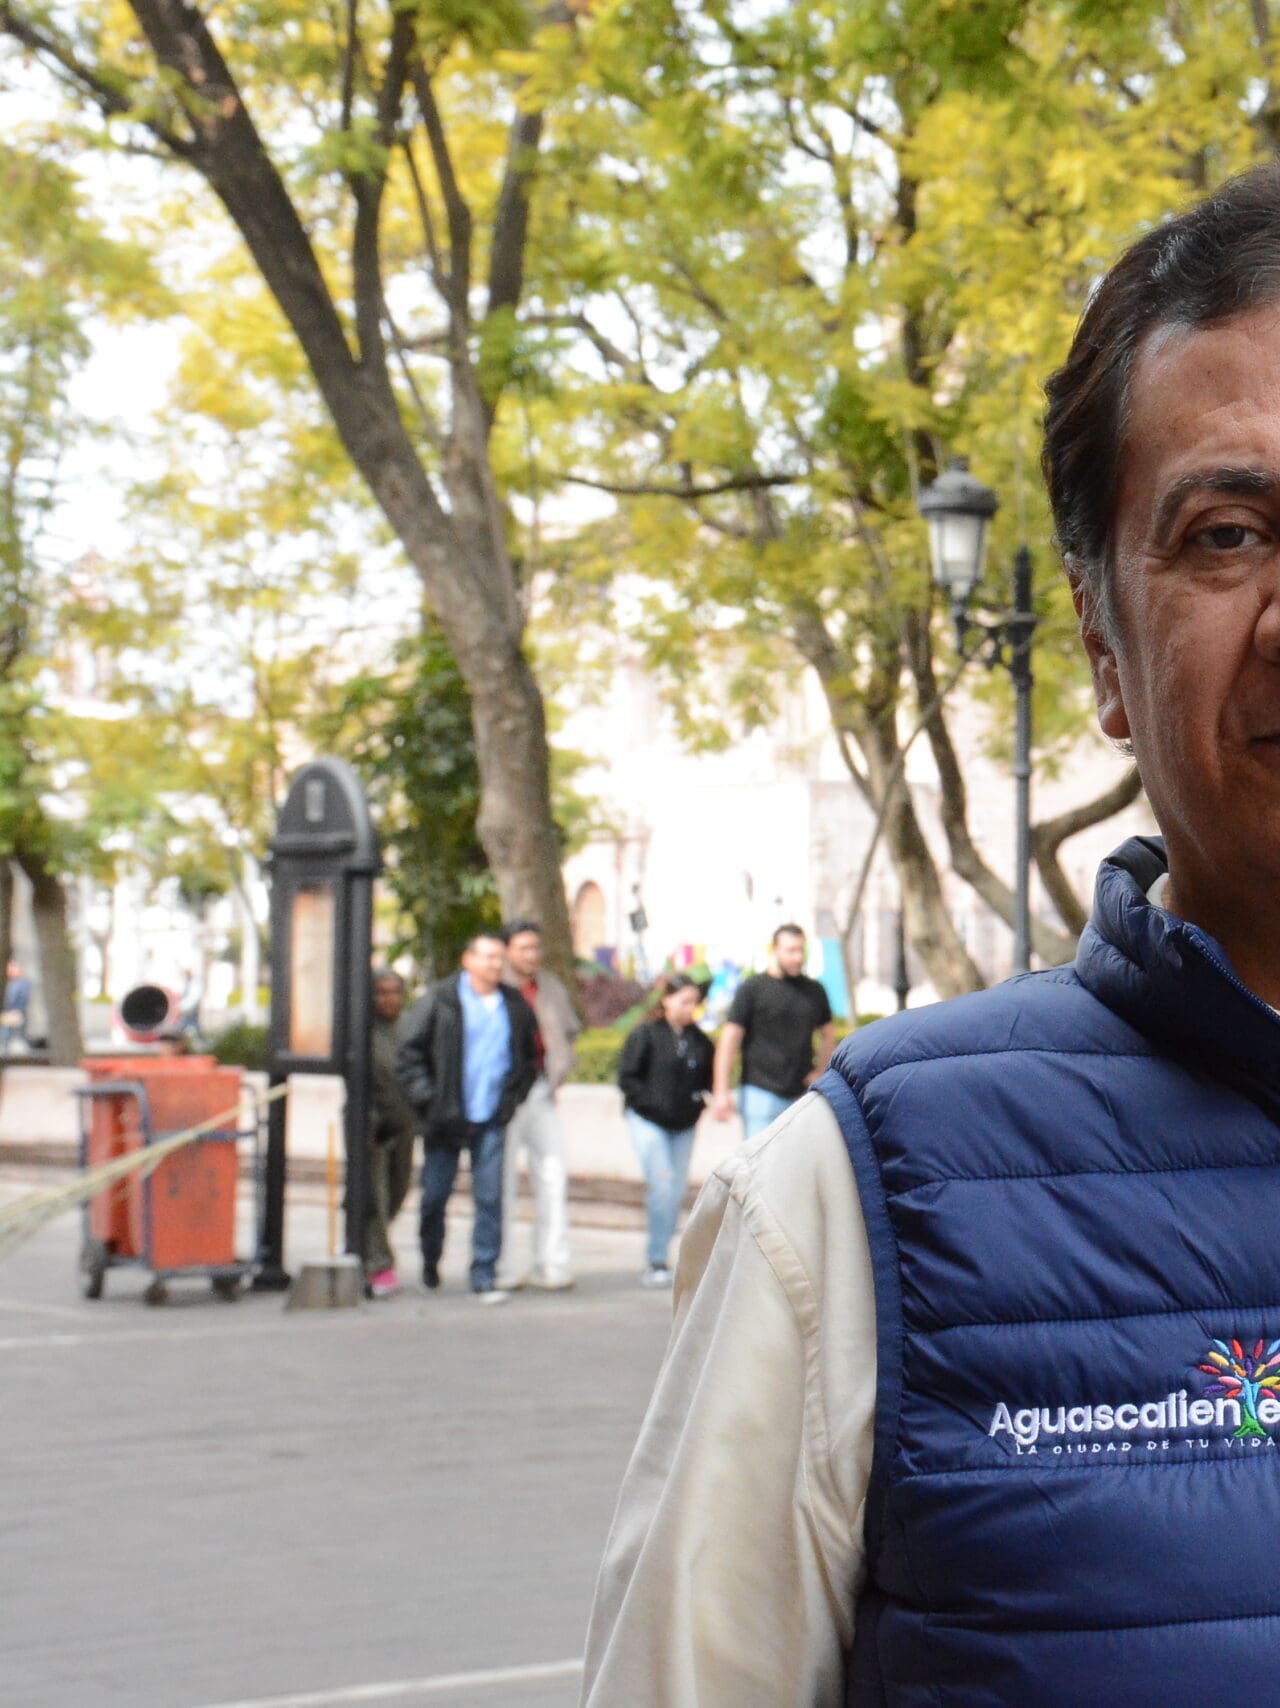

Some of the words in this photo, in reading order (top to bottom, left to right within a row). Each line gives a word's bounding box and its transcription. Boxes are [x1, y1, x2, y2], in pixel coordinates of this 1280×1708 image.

[1016, 1441, 1038, 1455] LA
[1146, 1439, 1170, 1451] DE
[1186, 1438, 1209, 1449] TU
[1223, 1436, 1276, 1448] VIDA
